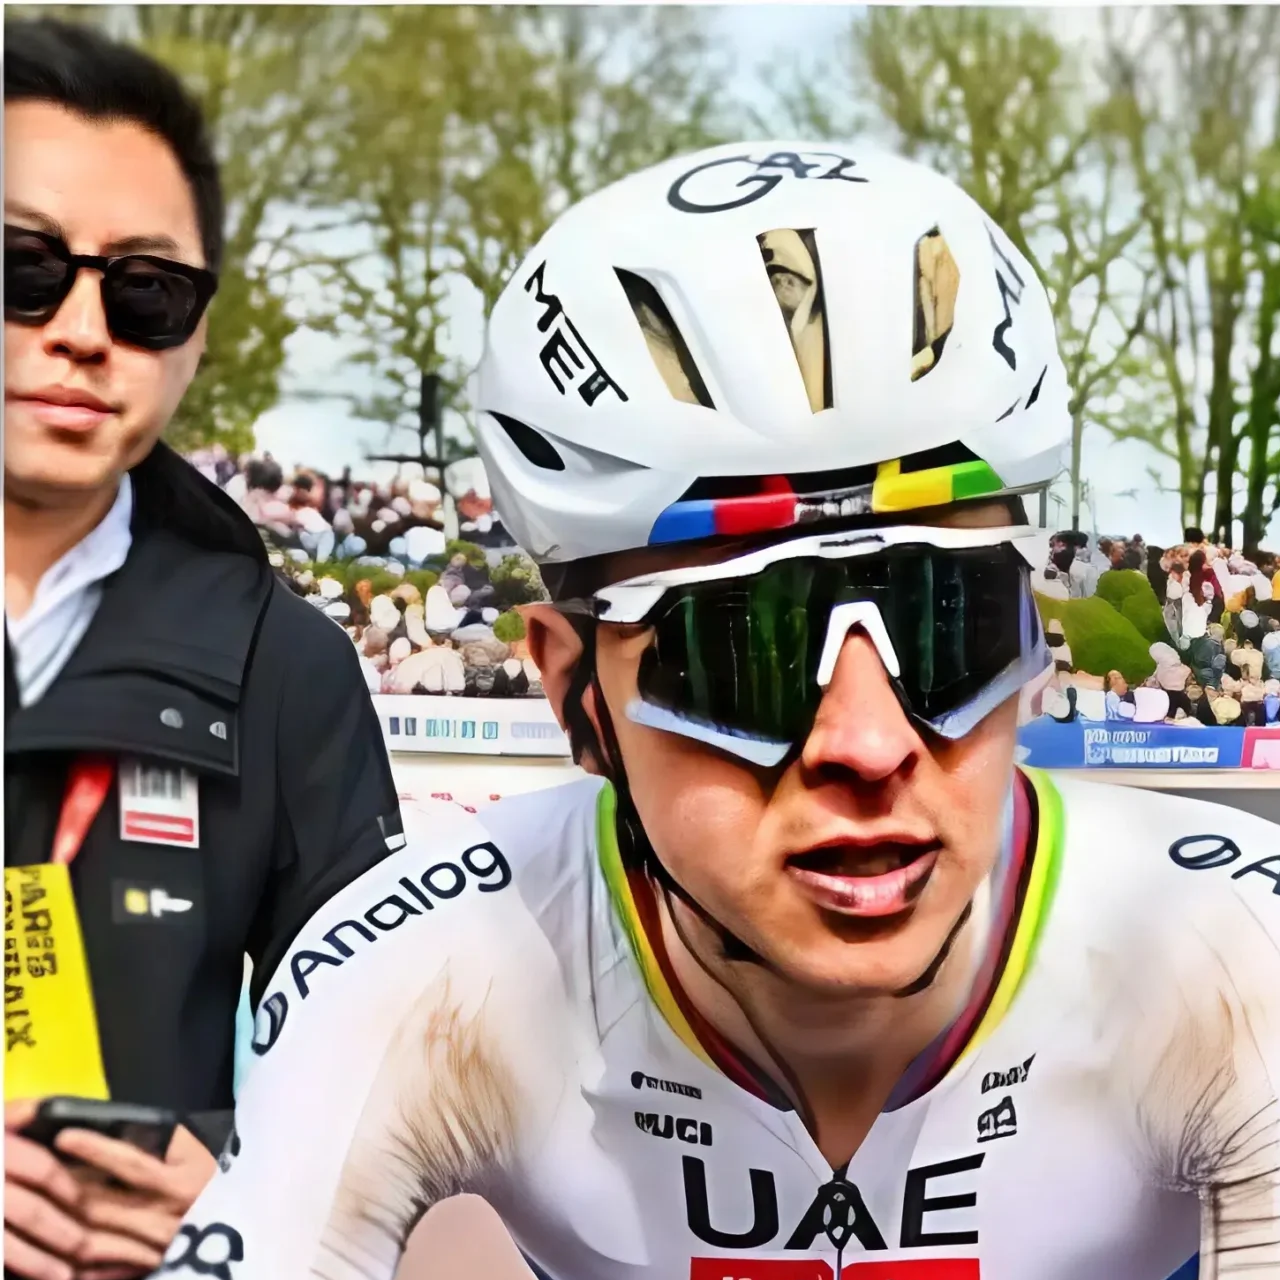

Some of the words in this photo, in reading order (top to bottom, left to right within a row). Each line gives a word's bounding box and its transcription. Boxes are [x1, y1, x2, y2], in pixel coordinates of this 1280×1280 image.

[524, 259, 629, 407] MET
[291, 842, 512, 999] Analog
[682, 1153, 986, 1250] UAE
